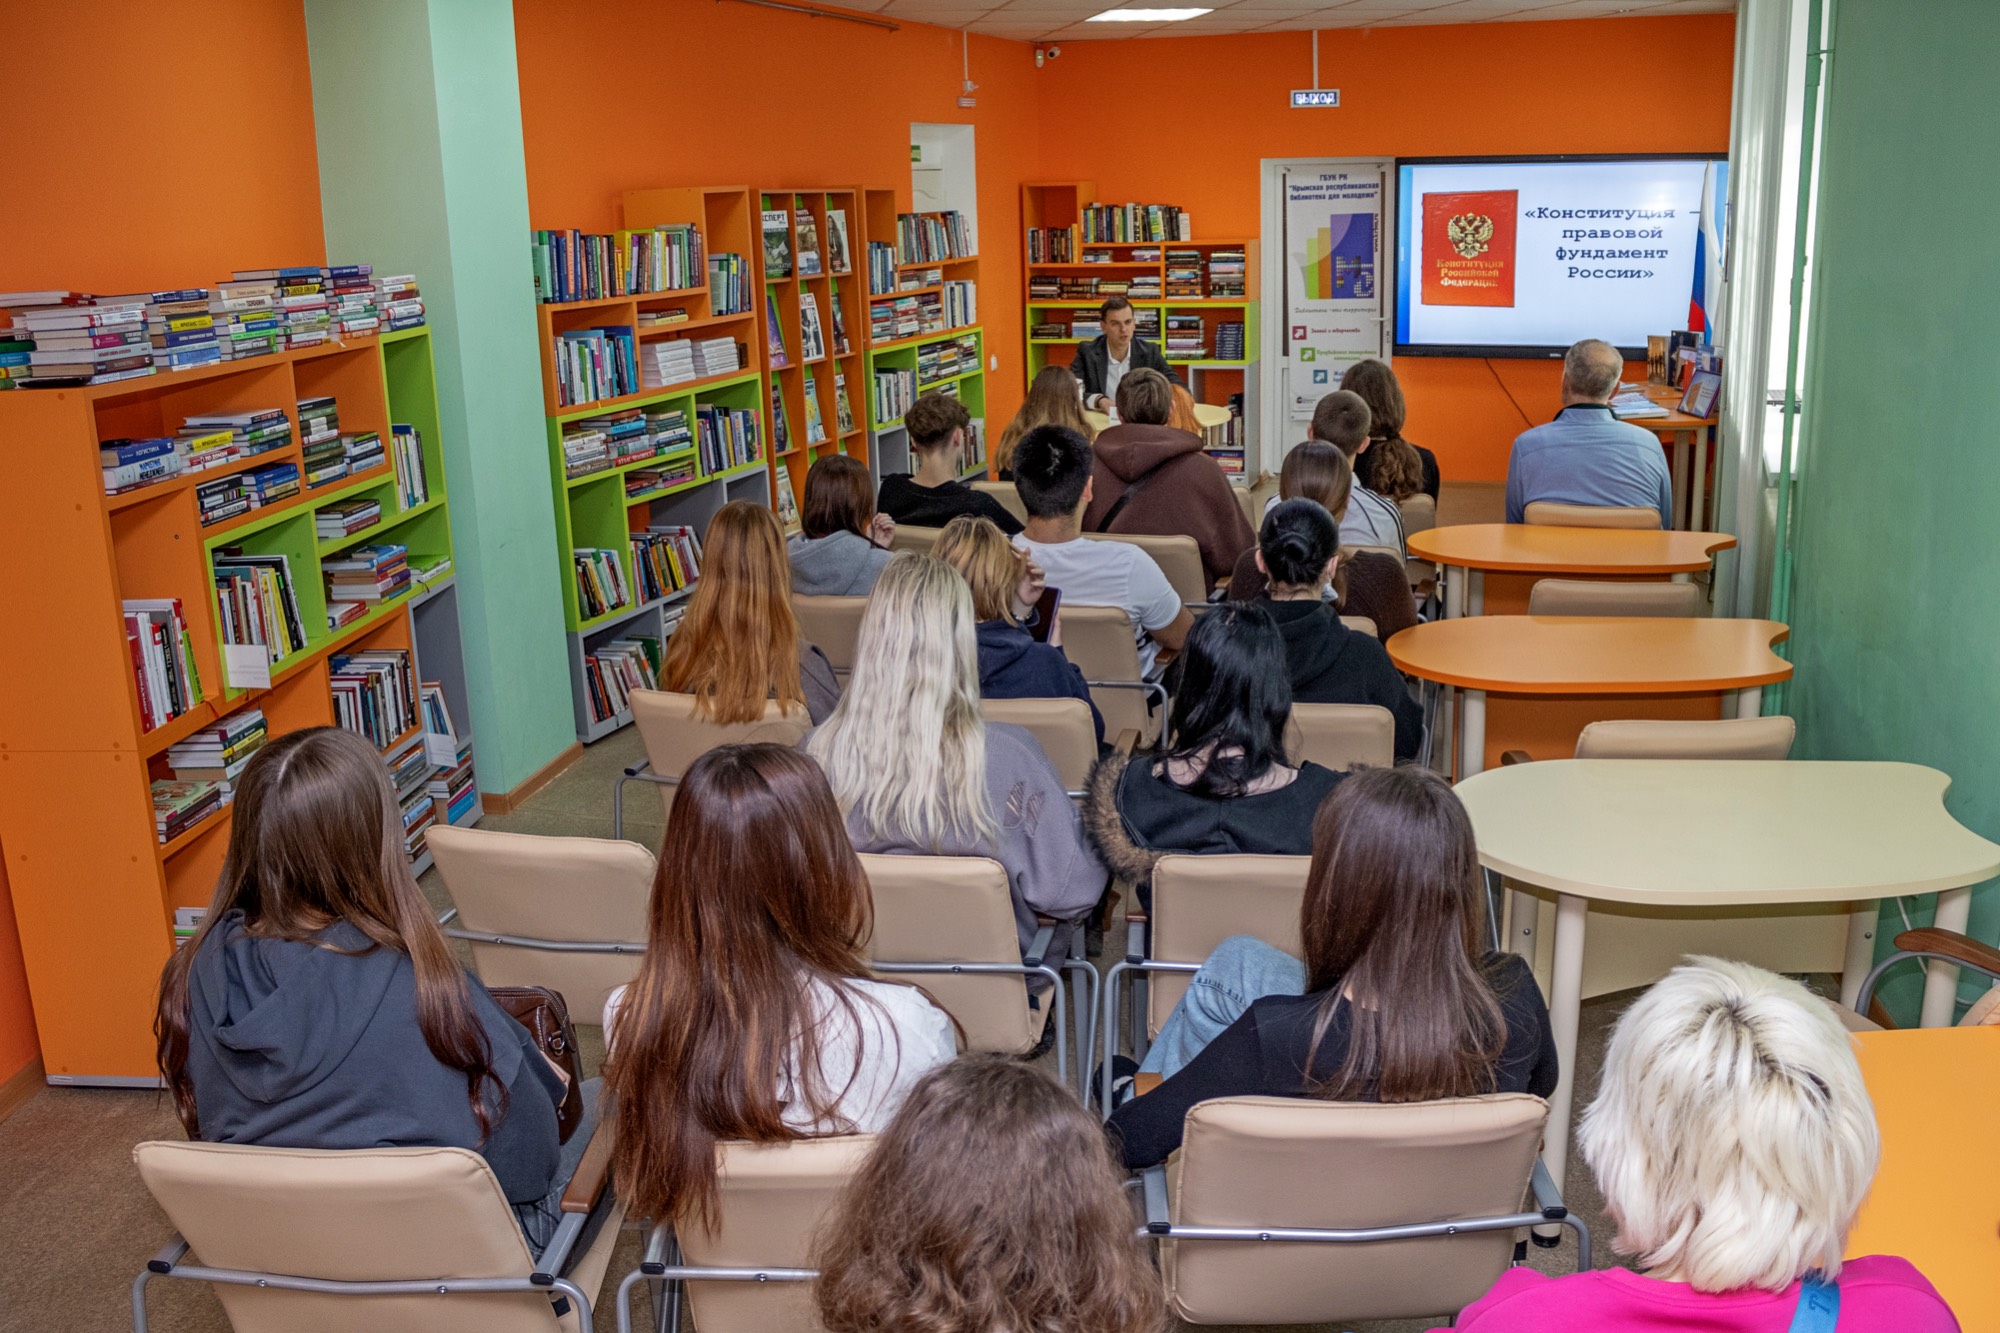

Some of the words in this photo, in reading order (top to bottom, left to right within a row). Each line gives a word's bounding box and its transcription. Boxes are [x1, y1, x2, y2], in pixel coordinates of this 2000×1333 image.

[1295, 93, 1335, 105] ВЫХОД
[1325, 182, 1380, 191] республиканская
[1290, 193, 1326, 201] библиотека
[1525, 207, 1676, 221] «Конституция
[1561, 226, 1663, 242] правовой
[1555, 246, 1669, 261] фундамент
[1567, 267, 1655, 279] России»
[136, 446, 160, 457] ЛОГИСТИКА
